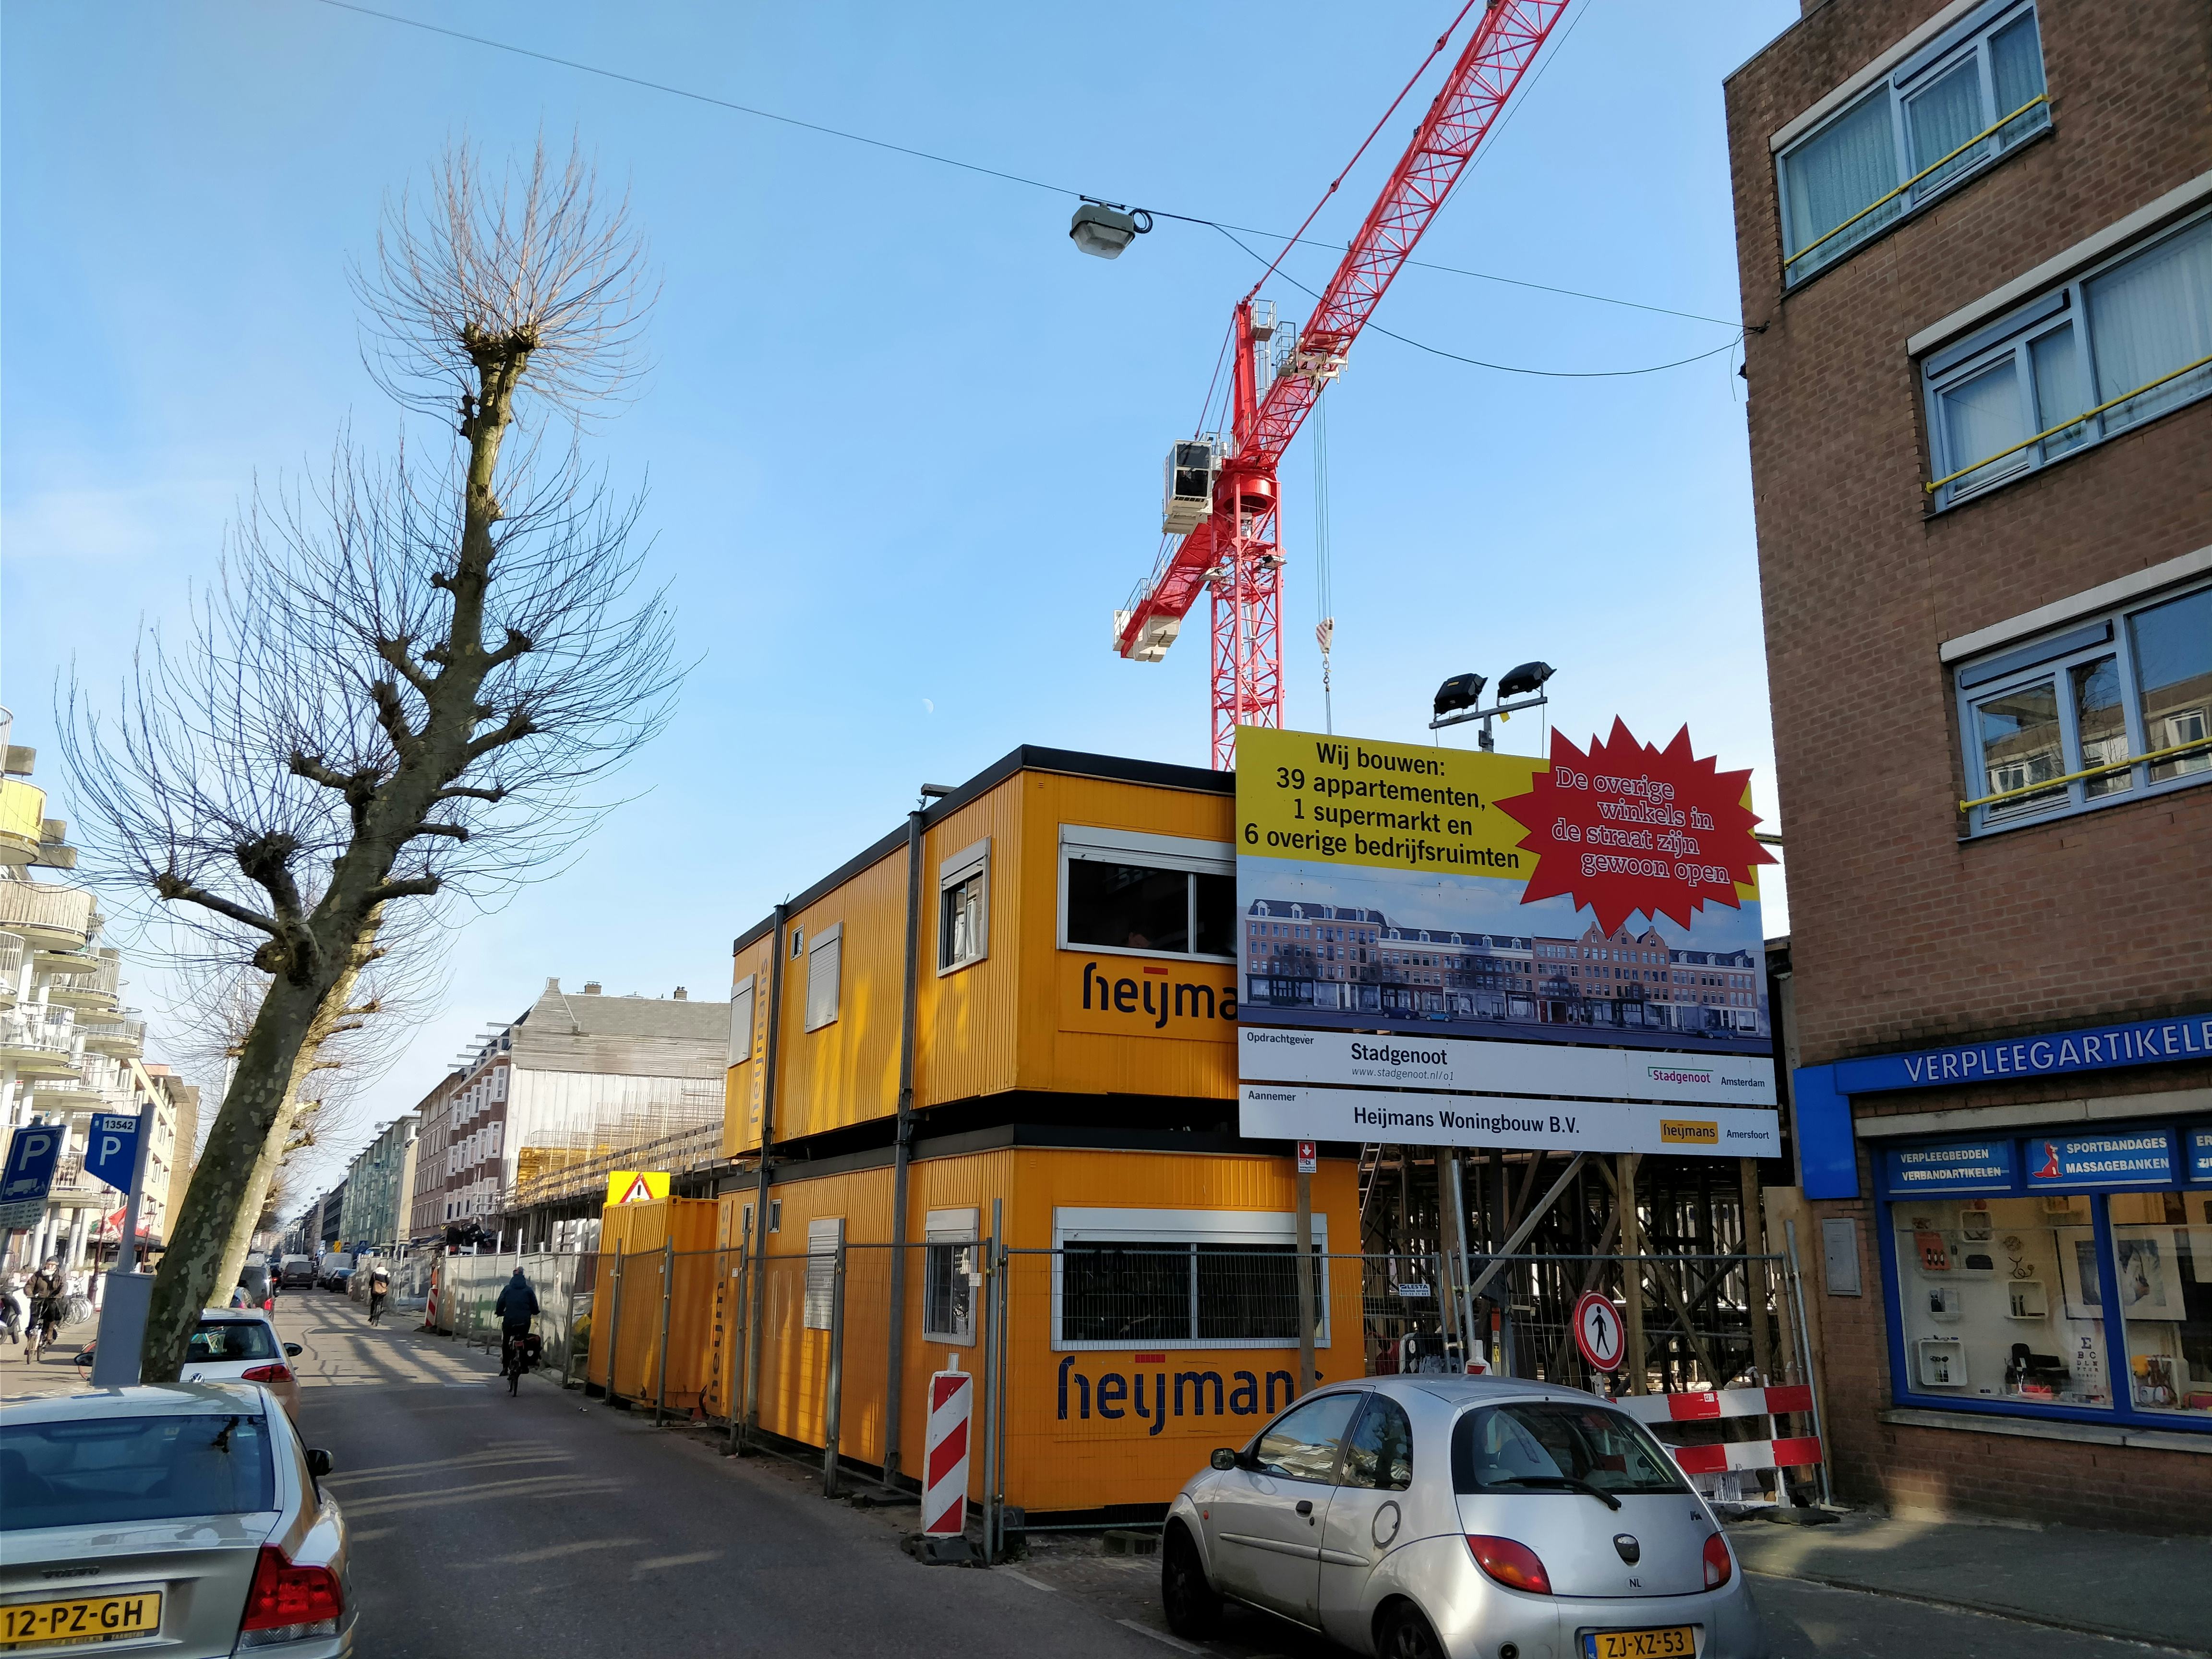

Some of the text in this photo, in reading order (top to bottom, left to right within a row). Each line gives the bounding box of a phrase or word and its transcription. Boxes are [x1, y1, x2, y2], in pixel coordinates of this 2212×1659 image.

[1316, 743, 1445, 776] Wij bouwen:
[1276, 767, 1486, 811] 39 appartementen,
[1555, 766, 1674, 805] De overige
[1294, 799, 1472, 835] 1 supermarkt en
[1597, 798, 1715, 830] winkels in
[1245, 823, 1519, 869] 6 overige bedrijfsruimten
[1551, 817, 1700, 858] de straat zijn
[1581, 853, 1731, 887] gewoon open
[750, 957, 768, 1123] heijmans
[1247, 1032, 1314, 1045] Opdrachtgever
[1351, 1043, 1448, 1065] Stadgenoot
[1352, 1067, 1454, 1081] www.stadgenoot.nl/o1
[1653, 1070, 1711, 1083] Stadgenoot
[1721, 1076, 1765, 1087] Amsterdam
[1248, 1090, 1297, 1101] Aannemer
[104, 1119, 133, 1130] 13542
[1354, 1106, 1580, 1133] Heijmans Woningbouw B.V.
[1663, 1123, 1716, 1140] heijmans
[1727, 1129, 1769, 1140] Amersfoort
[2067, 1137, 2167, 1154] SPORTBANDAGES
[18, 1134, 50, 1171] P
[99, 1136, 122, 1166] P
[1900, 1149, 1989, 1164] VERPLEEGBEDDEN
[1902, 1167, 2001, 1181] VERBANDARTIKELEN
[2066, 1158, 2169, 1174] MASSAGEBANKEN
[2081, 1337, 2092, 1349] E
[1058, 1355, 1323, 1436] heijman
[1629, 1578, 1642, 1588] NL
[6, 1599, 143, 1637] 12-PZ-GH
[1606, 1631, 1684, 1658] ZJ-XZ-53
